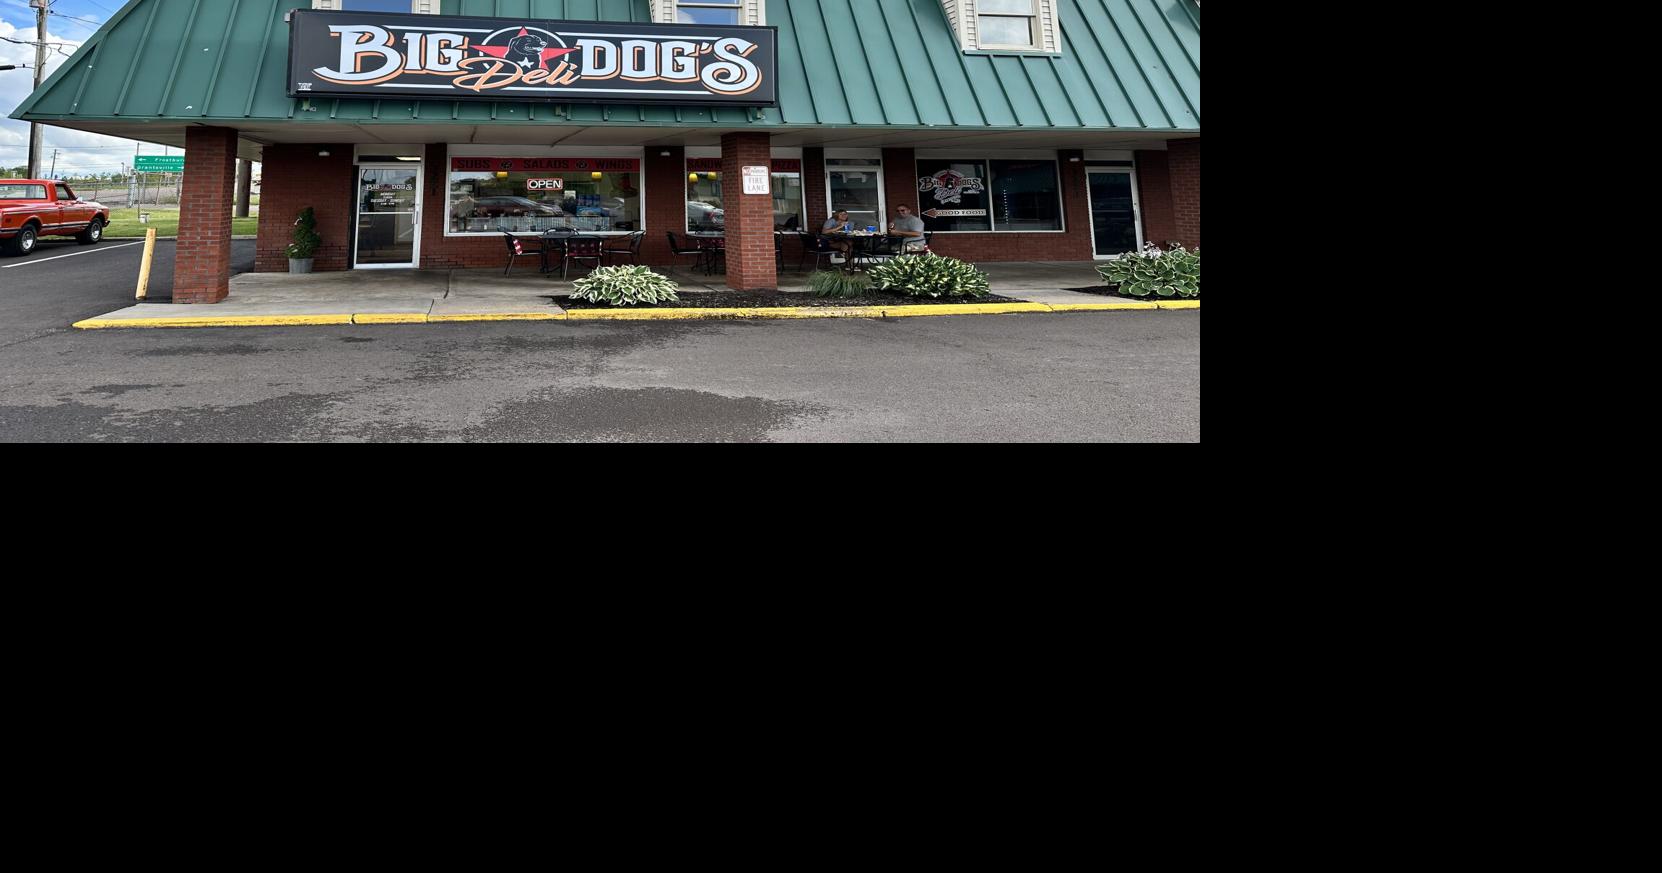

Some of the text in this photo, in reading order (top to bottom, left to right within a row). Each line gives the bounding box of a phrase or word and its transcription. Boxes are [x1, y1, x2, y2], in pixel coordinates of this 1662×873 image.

[312, 25, 763, 95] BIG DOG'S
[452, 56, 581, 92] Deli
[457, 159, 633, 169] SUBS SALADS WINGS
[528, 180, 562, 189] OPEN
[747, 184, 766, 192] LANE
